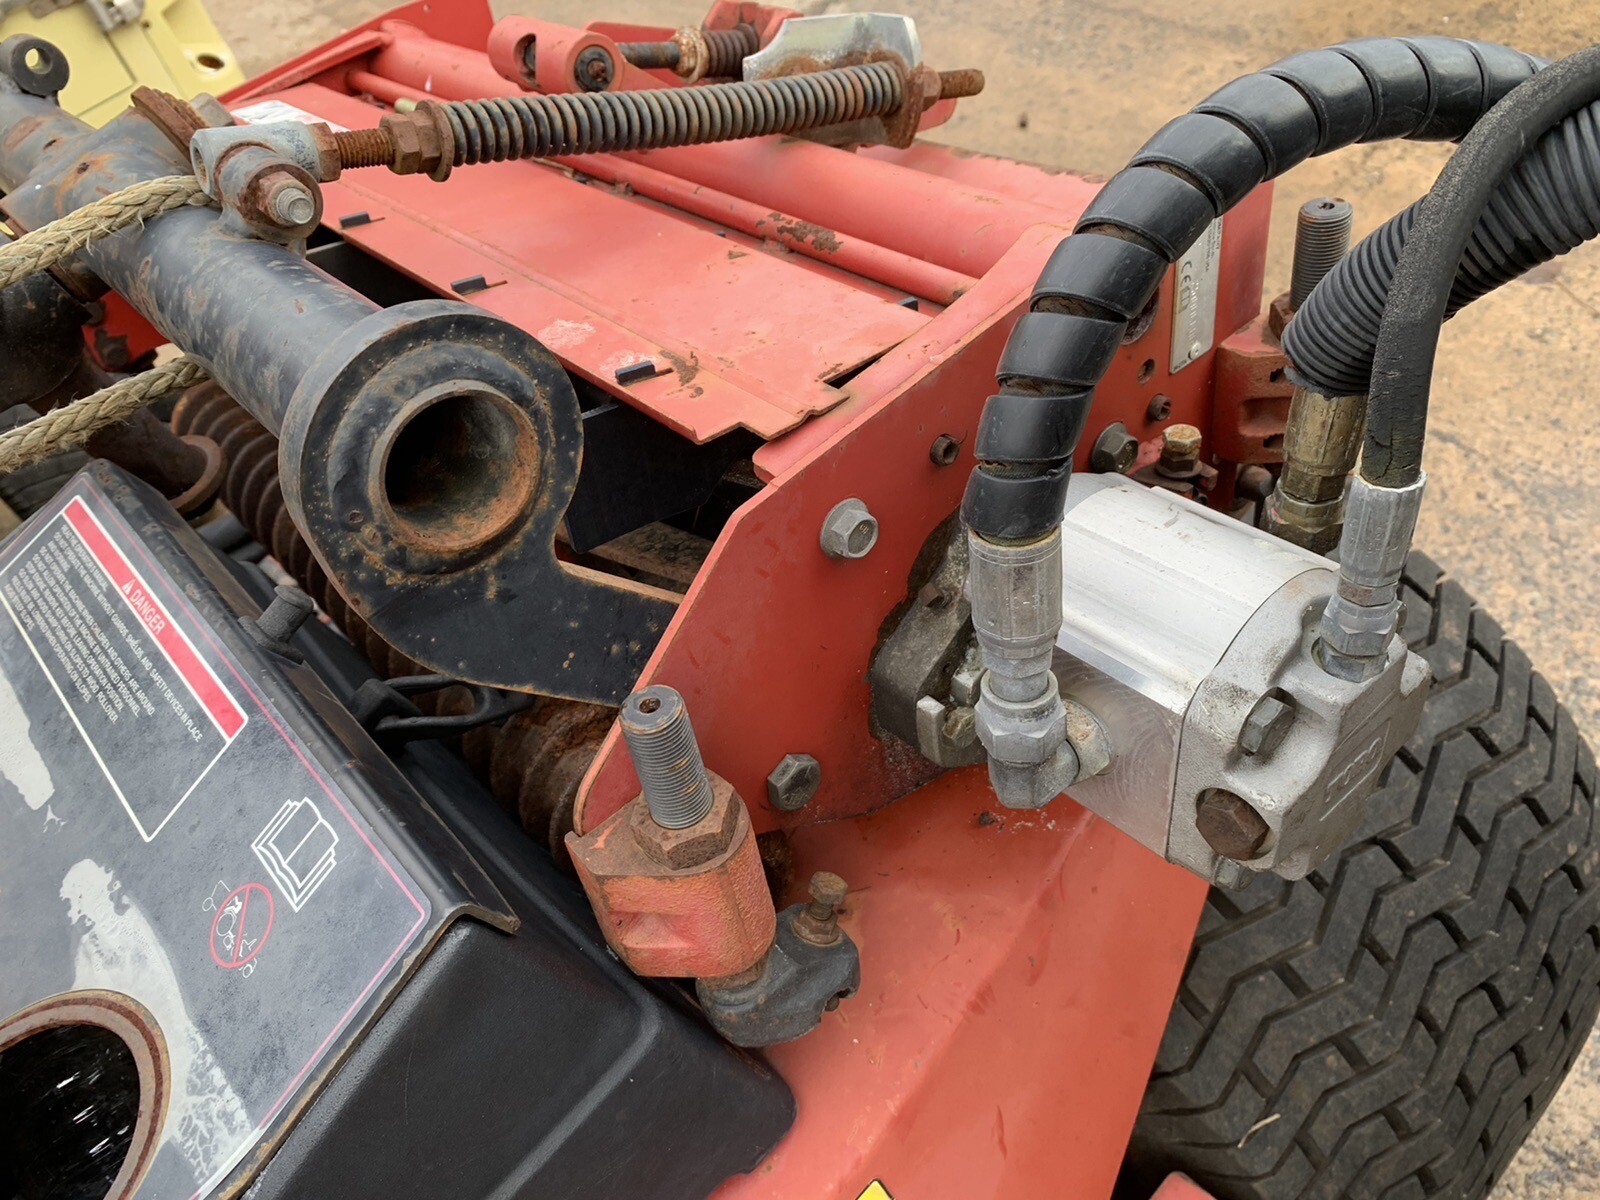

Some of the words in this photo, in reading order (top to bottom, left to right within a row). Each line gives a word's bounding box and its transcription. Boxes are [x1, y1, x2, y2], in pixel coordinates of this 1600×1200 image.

[30, 606, 49, 634] LOWERED
[44, 629, 57, 648] WHEN
[52, 642, 73, 675] OPERATING
[30, 586, 40, 601] AND
[36, 595, 49, 614] AVOID
[44, 609, 58, 629] SHARP
[68, 647, 85, 672] SLOPES
[84, 674, 99, 695] AVOID
[94, 690, 118, 726] ROLLOVER.
[36, 559, 46, 572] NOT
[42, 568, 56, 587] ALLOW
[51, 582, 72, 612] OPERATION
[71, 613, 83, 628] THE
[78, 623, 97, 650] MACHINE
[96, 651, 120, 685] UNTRAINED
[115, 680, 142, 719] PERSONNEL.
[42, 587, 59, 611] REMOVE
[54, 606, 65, 620] KEY
[60, 615, 77, 639] BEFORE
[72, 634, 90, 659] LEAVING
[85, 654, 108, 688] OPERATION
[103, 682, 124, 714] POSITION.
[43, 551, 53, 565] NOT
[62, 580, 72, 593] THE
[67, 588, 85, 613] MACHINE
[80, 607, 95, 627] WHEN
[90, 621, 110, 650] CHILDREN
[106, 645, 118, 662] AND
[113, 656, 131, 682] OTHERS
[126, 677, 139, 693] ARE
[134, 688, 155, 718] AROUND.
[63, 545, 81, 569] OPERATE
[76, 564, 87, 578] THE
[82, 573, 100, 597] MACHINE
[96, 592, 114, 617] WITHOUT
[140, 655, 153, 672] AND
[148, 667, 168, 693] SAFETY
[163, 687, 184, 717] DEVICES
[184, 718, 203, 743] PLACE
[130, 588, 166, 635] DANGER
